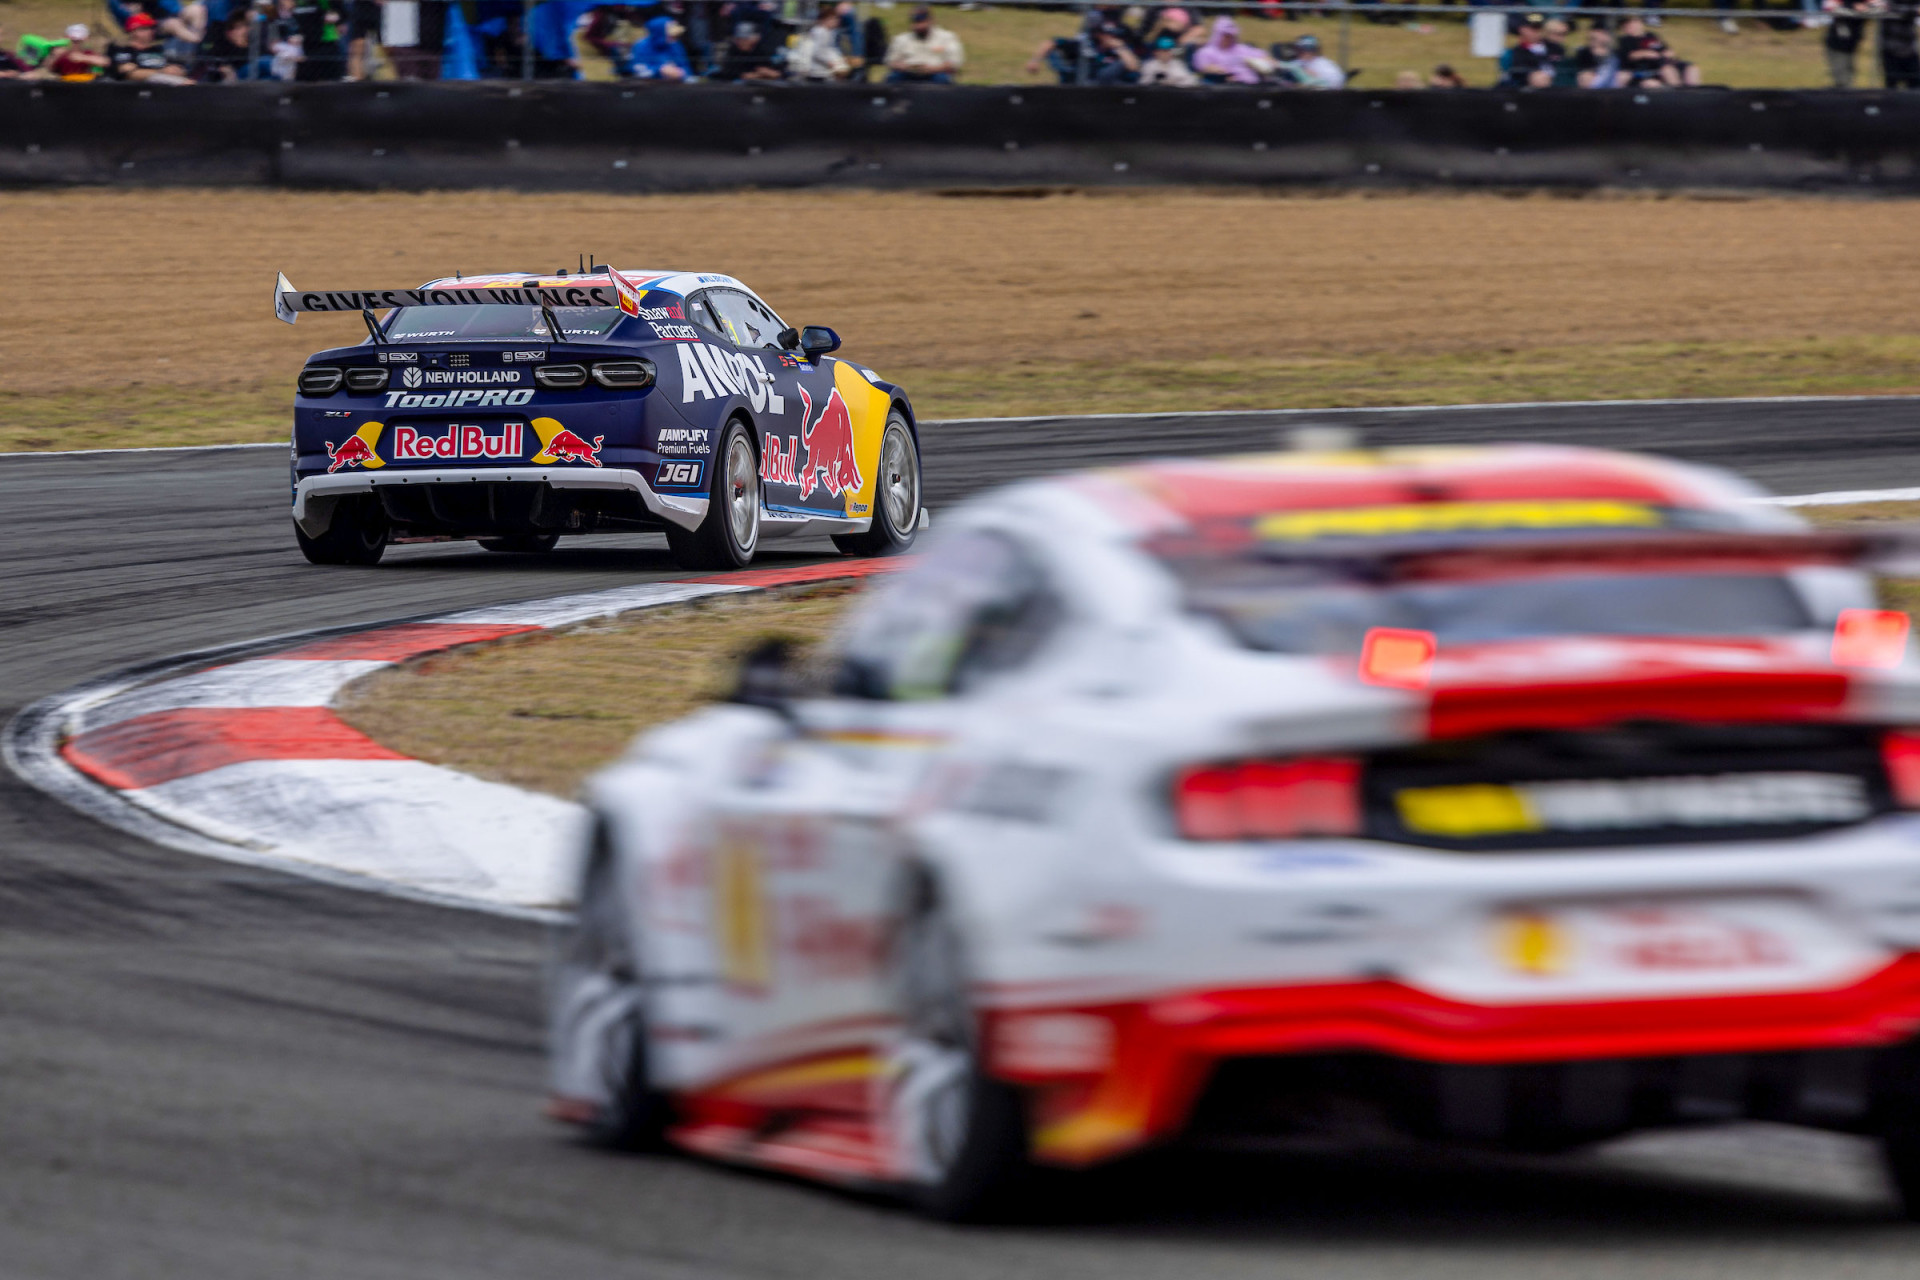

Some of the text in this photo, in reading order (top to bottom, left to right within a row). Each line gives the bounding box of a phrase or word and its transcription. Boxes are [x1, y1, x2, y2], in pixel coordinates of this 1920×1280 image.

[302, 292, 402, 311] GIVES
[405, 289, 483, 305] YOU
[488, 288, 612, 307] WINGS
[648, 321, 698, 339] Partners
[425, 371, 521, 384] NEW HOLLAND
[384, 389, 536, 408] ToolPRO
[394, 422, 524, 459] Red Bull
[665, 429, 709, 442] AMPLIFY
[657, 443, 711, 454] Premium Fuels
[770, 434, 799, 486] Bull
[658, 463, 699, 483] JGI
